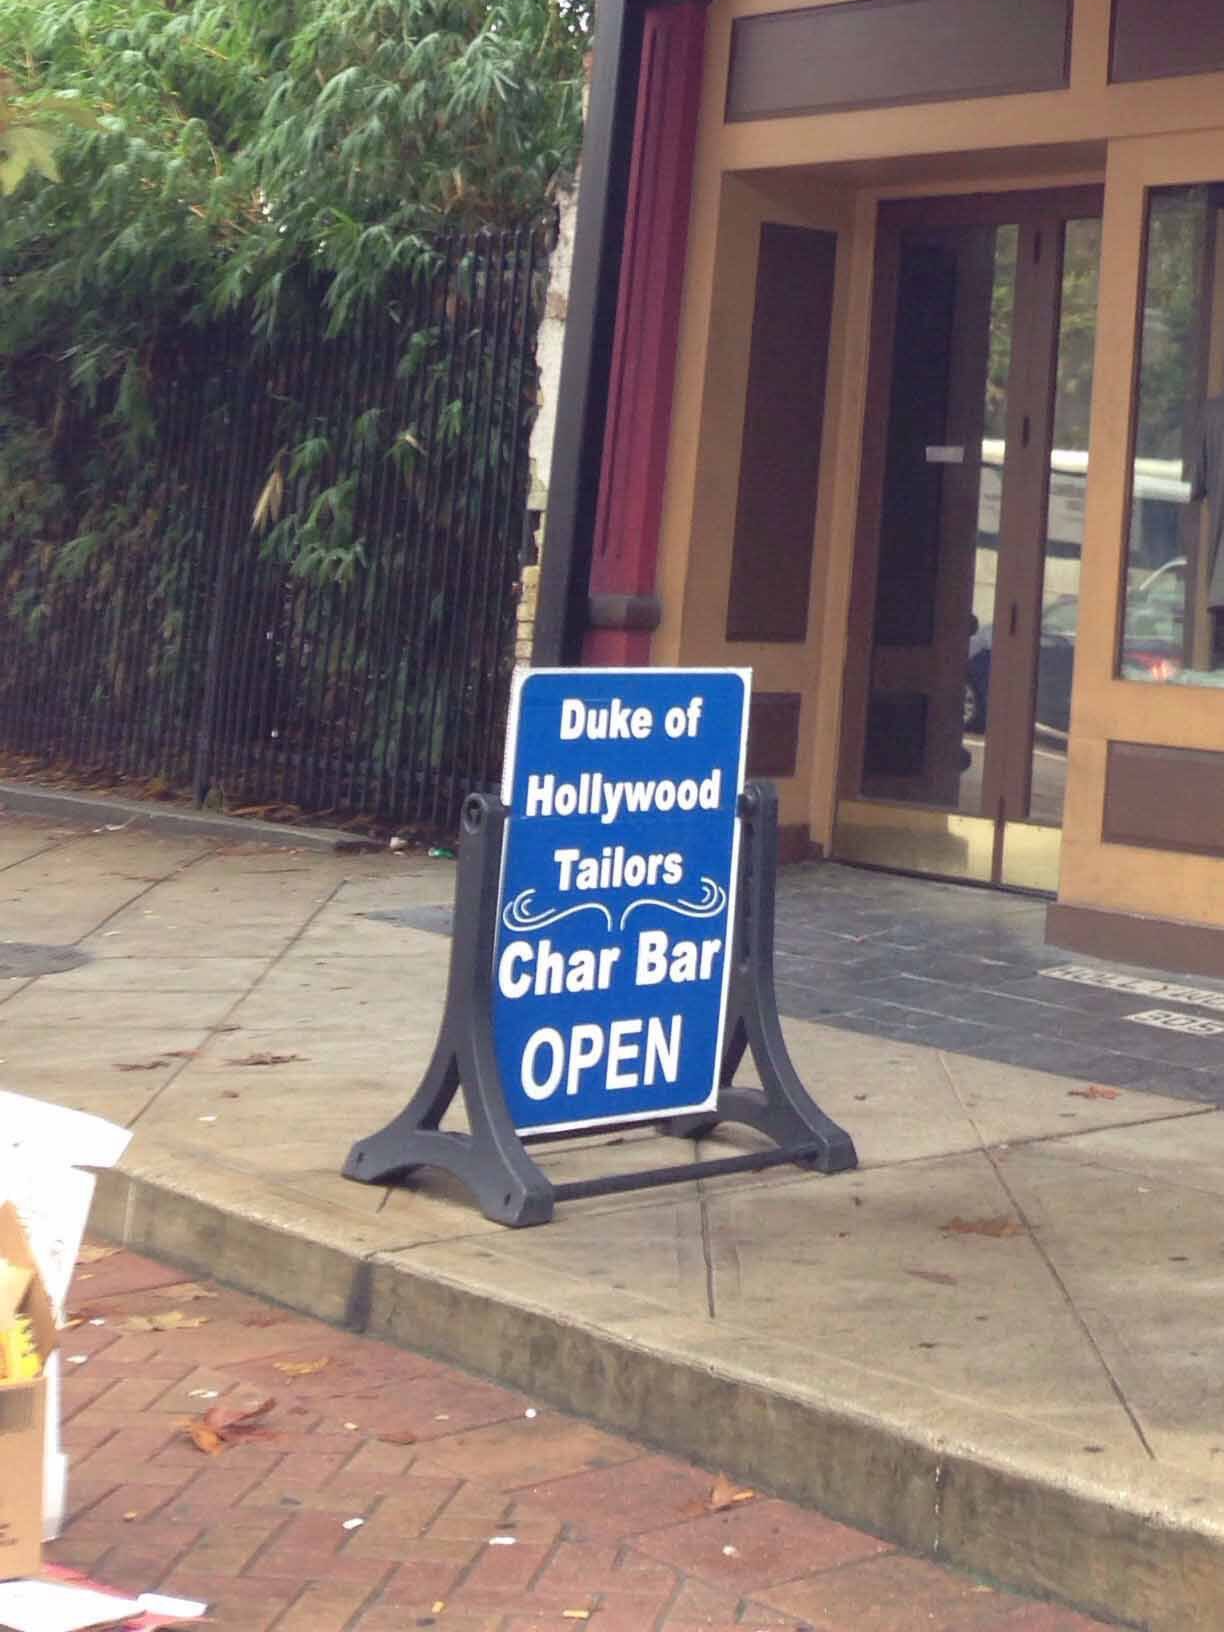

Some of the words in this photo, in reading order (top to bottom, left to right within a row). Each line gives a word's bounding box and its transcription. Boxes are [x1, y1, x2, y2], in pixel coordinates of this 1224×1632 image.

[558, 697, 653, 741] Duke
[664, 697, 704, 737] of
[525, 769, 722, 824] Hollywood
[553, 846, 684, 892] Tailors
[498, 939, 625, 1000] Char
[635, 930, 721, 986] Bar
[520, 1014, 683, 1101] OPEN
